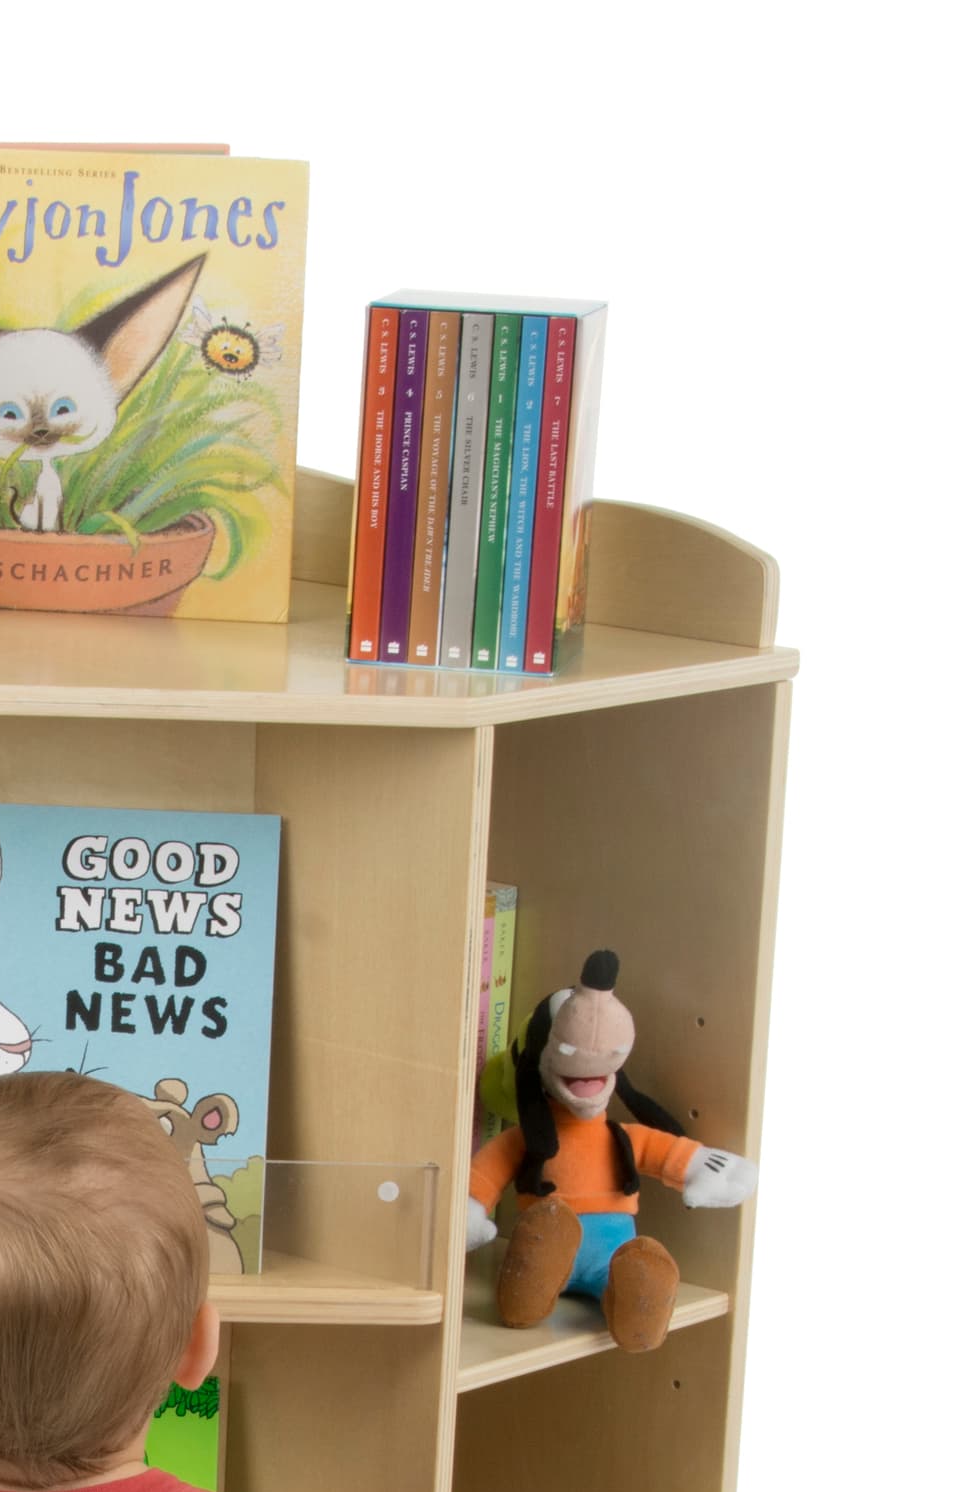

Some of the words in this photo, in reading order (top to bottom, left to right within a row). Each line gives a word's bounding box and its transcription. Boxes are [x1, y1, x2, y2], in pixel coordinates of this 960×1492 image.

[379, 342, 389, 374] LEWIS
[407, 344, 416, 376] LEWIS
[498, 349, 508, 382] LEWIS
[556, 352, 565, 383] LEWIS
[376, 410, 384, 431] THE
[402, 411, 412, 447] PRINCE
[551, 421, 560, 440] THE
[374, 434, 383, 466] HORSE
[550, 444, 559, 468] LAST
[372, 469, 381, 489] AND
[400, 449, 410, 492] CASPIAN
[371, 491, 380, 508] HIS
[546, 470, 558, 509] BATTLE
[370, 510, 378, 528] BOY
[488, 501, 497, 543] NEPHEW
[63, 835, 240, 886] GOOD
[56, 886, 243, 938] NEWS
[94, 941, 207, 987] BAD
[65, 989, 228, 1039] NEWS
[492, 1001, 505, 1056] DRAGO
